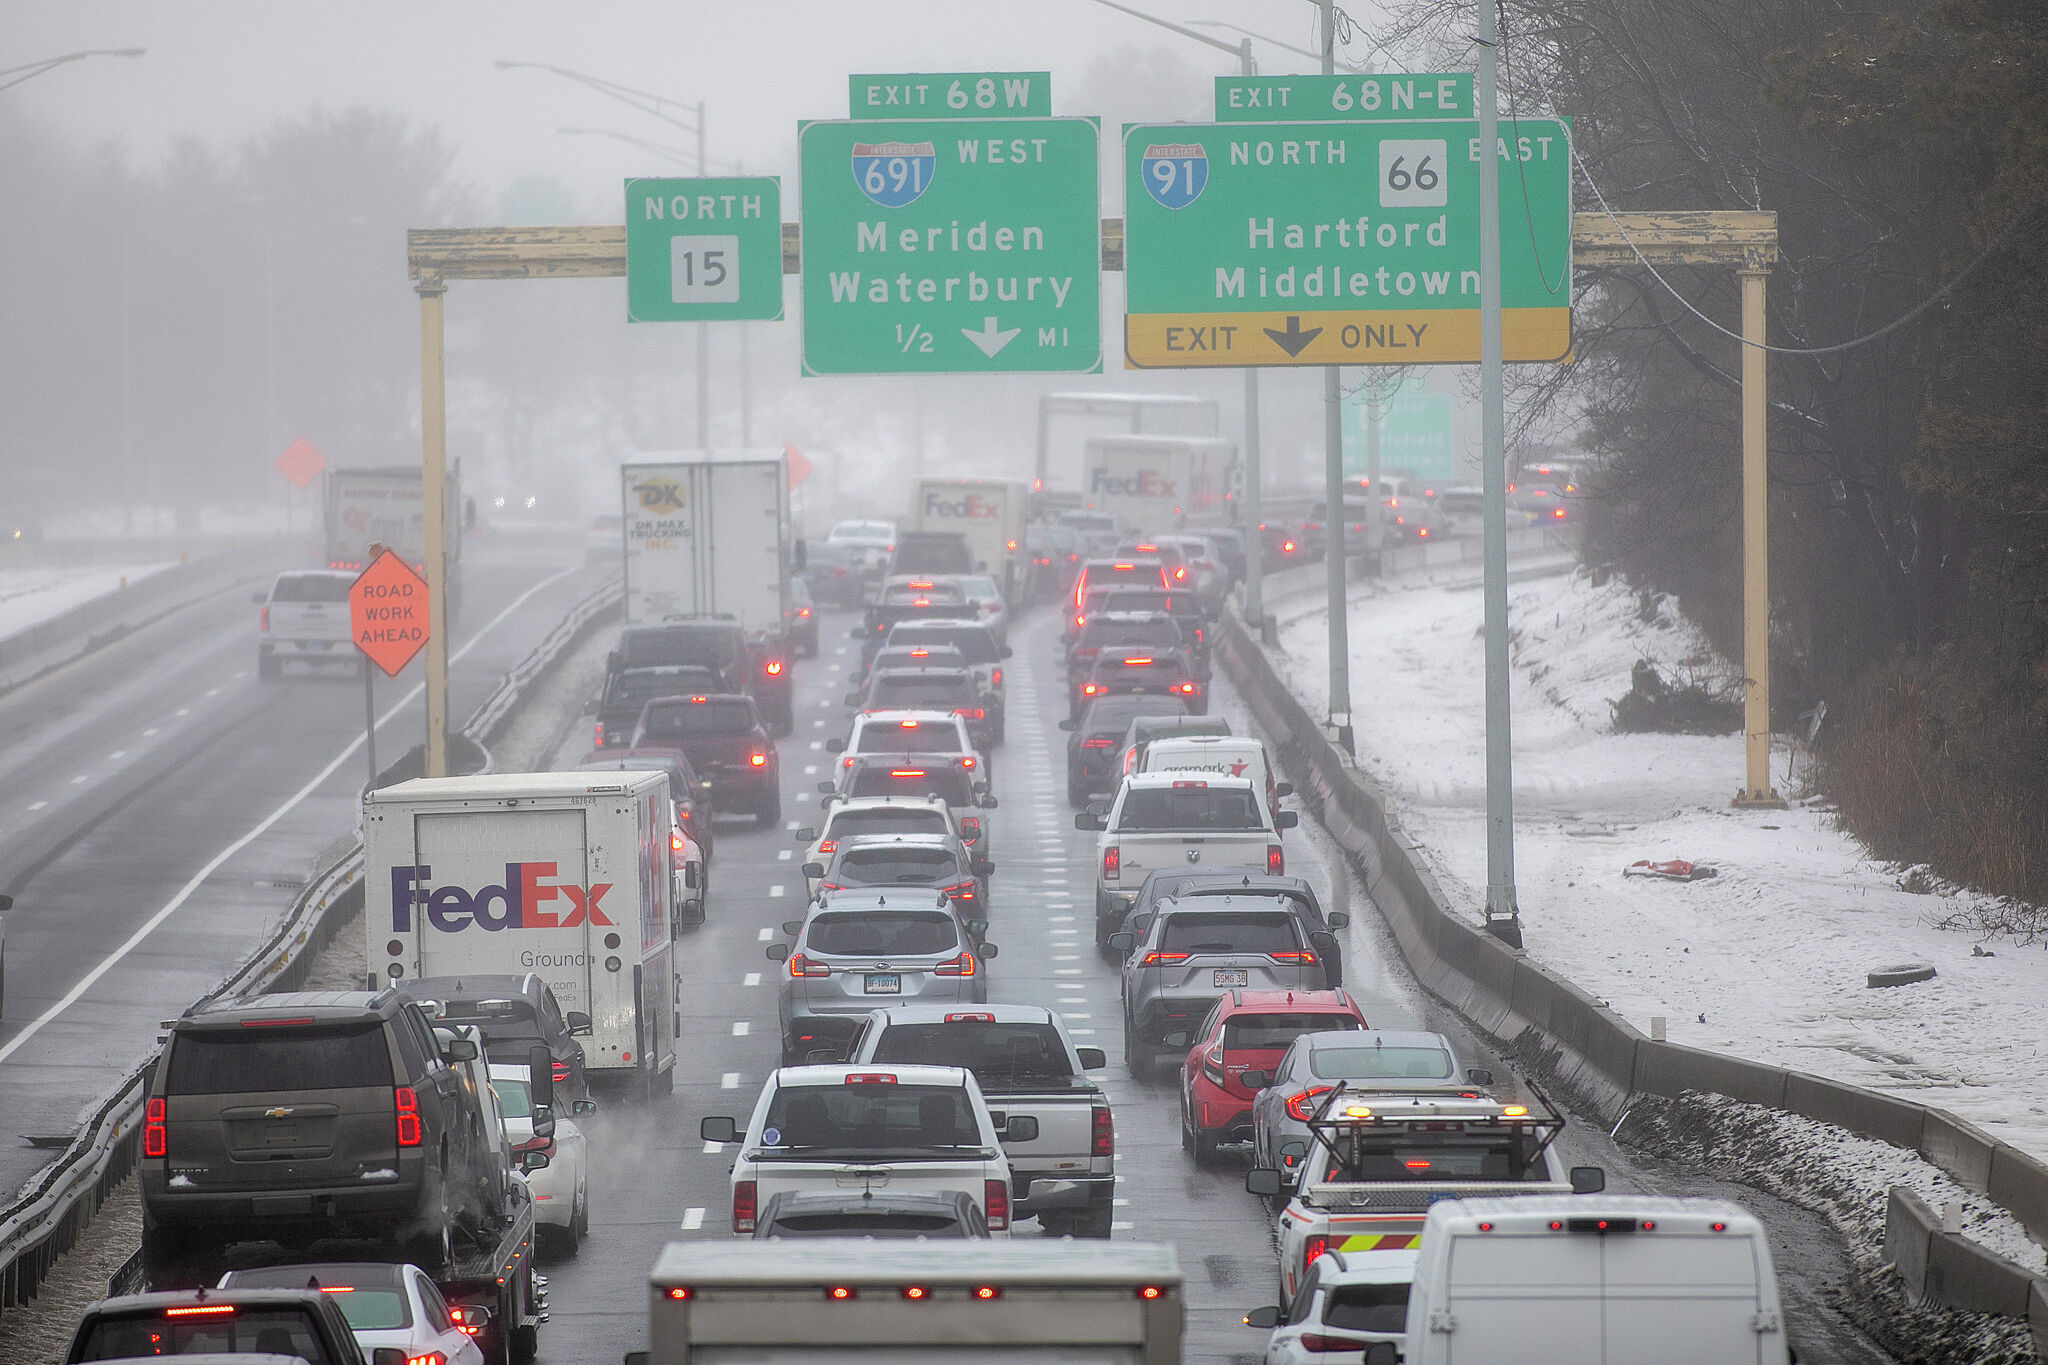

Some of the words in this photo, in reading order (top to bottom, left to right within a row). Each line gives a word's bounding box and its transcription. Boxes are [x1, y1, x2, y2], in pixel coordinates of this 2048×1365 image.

[867, 85, 930, 106] EXIT
[947, 79, 1030, 110] 68W
[1229, 87, 1291, 107] EXIT
[1331, 79, 1459, 113] 68N-E
[957, 139, 1048, 164] WEST
[1152, 147, 1197, 156] INTERSTATE
[1230, 140, 1346, 165] NORTH
[1468, 136, 1552, 162] EAST
[865, 157, 921, 194] 691
[1152, 159, 1193, 196] 91
[1387, 156, 1438, 191] 66
[645, 195, 762, 220] NORTH
[857, 221, 1043, 252] Meriden
[1248, 214, 1446, 250] Hartford
[683, 250, 727, 287] 15
[1216, 265, 1481, 299] Middletown
[830, 271, 1073, 309] Waterbury
[895, 323, 934, 354] 1/2
[1038, 327, 1069, 347] MI
[1166, 326, 1237, 351] EXIT
[1341, 323, 1428, 349] ONLY
[1091, 467, 1177, 497] FedEx
[924, 492, 999, 520] FedEx
[630, 528, 692, 539] TRUCKING
[657, 519, 685, 529] MAX
[645, 539, 679, 551] INC.
[364, 583, 414, 600] ROAD
[364, 605, 415, 621] WORK
[360, 626, 423, 643] AHEAD
[391, 862, 614, 933] FedEx
[521, 950, 585, 967] Ground
